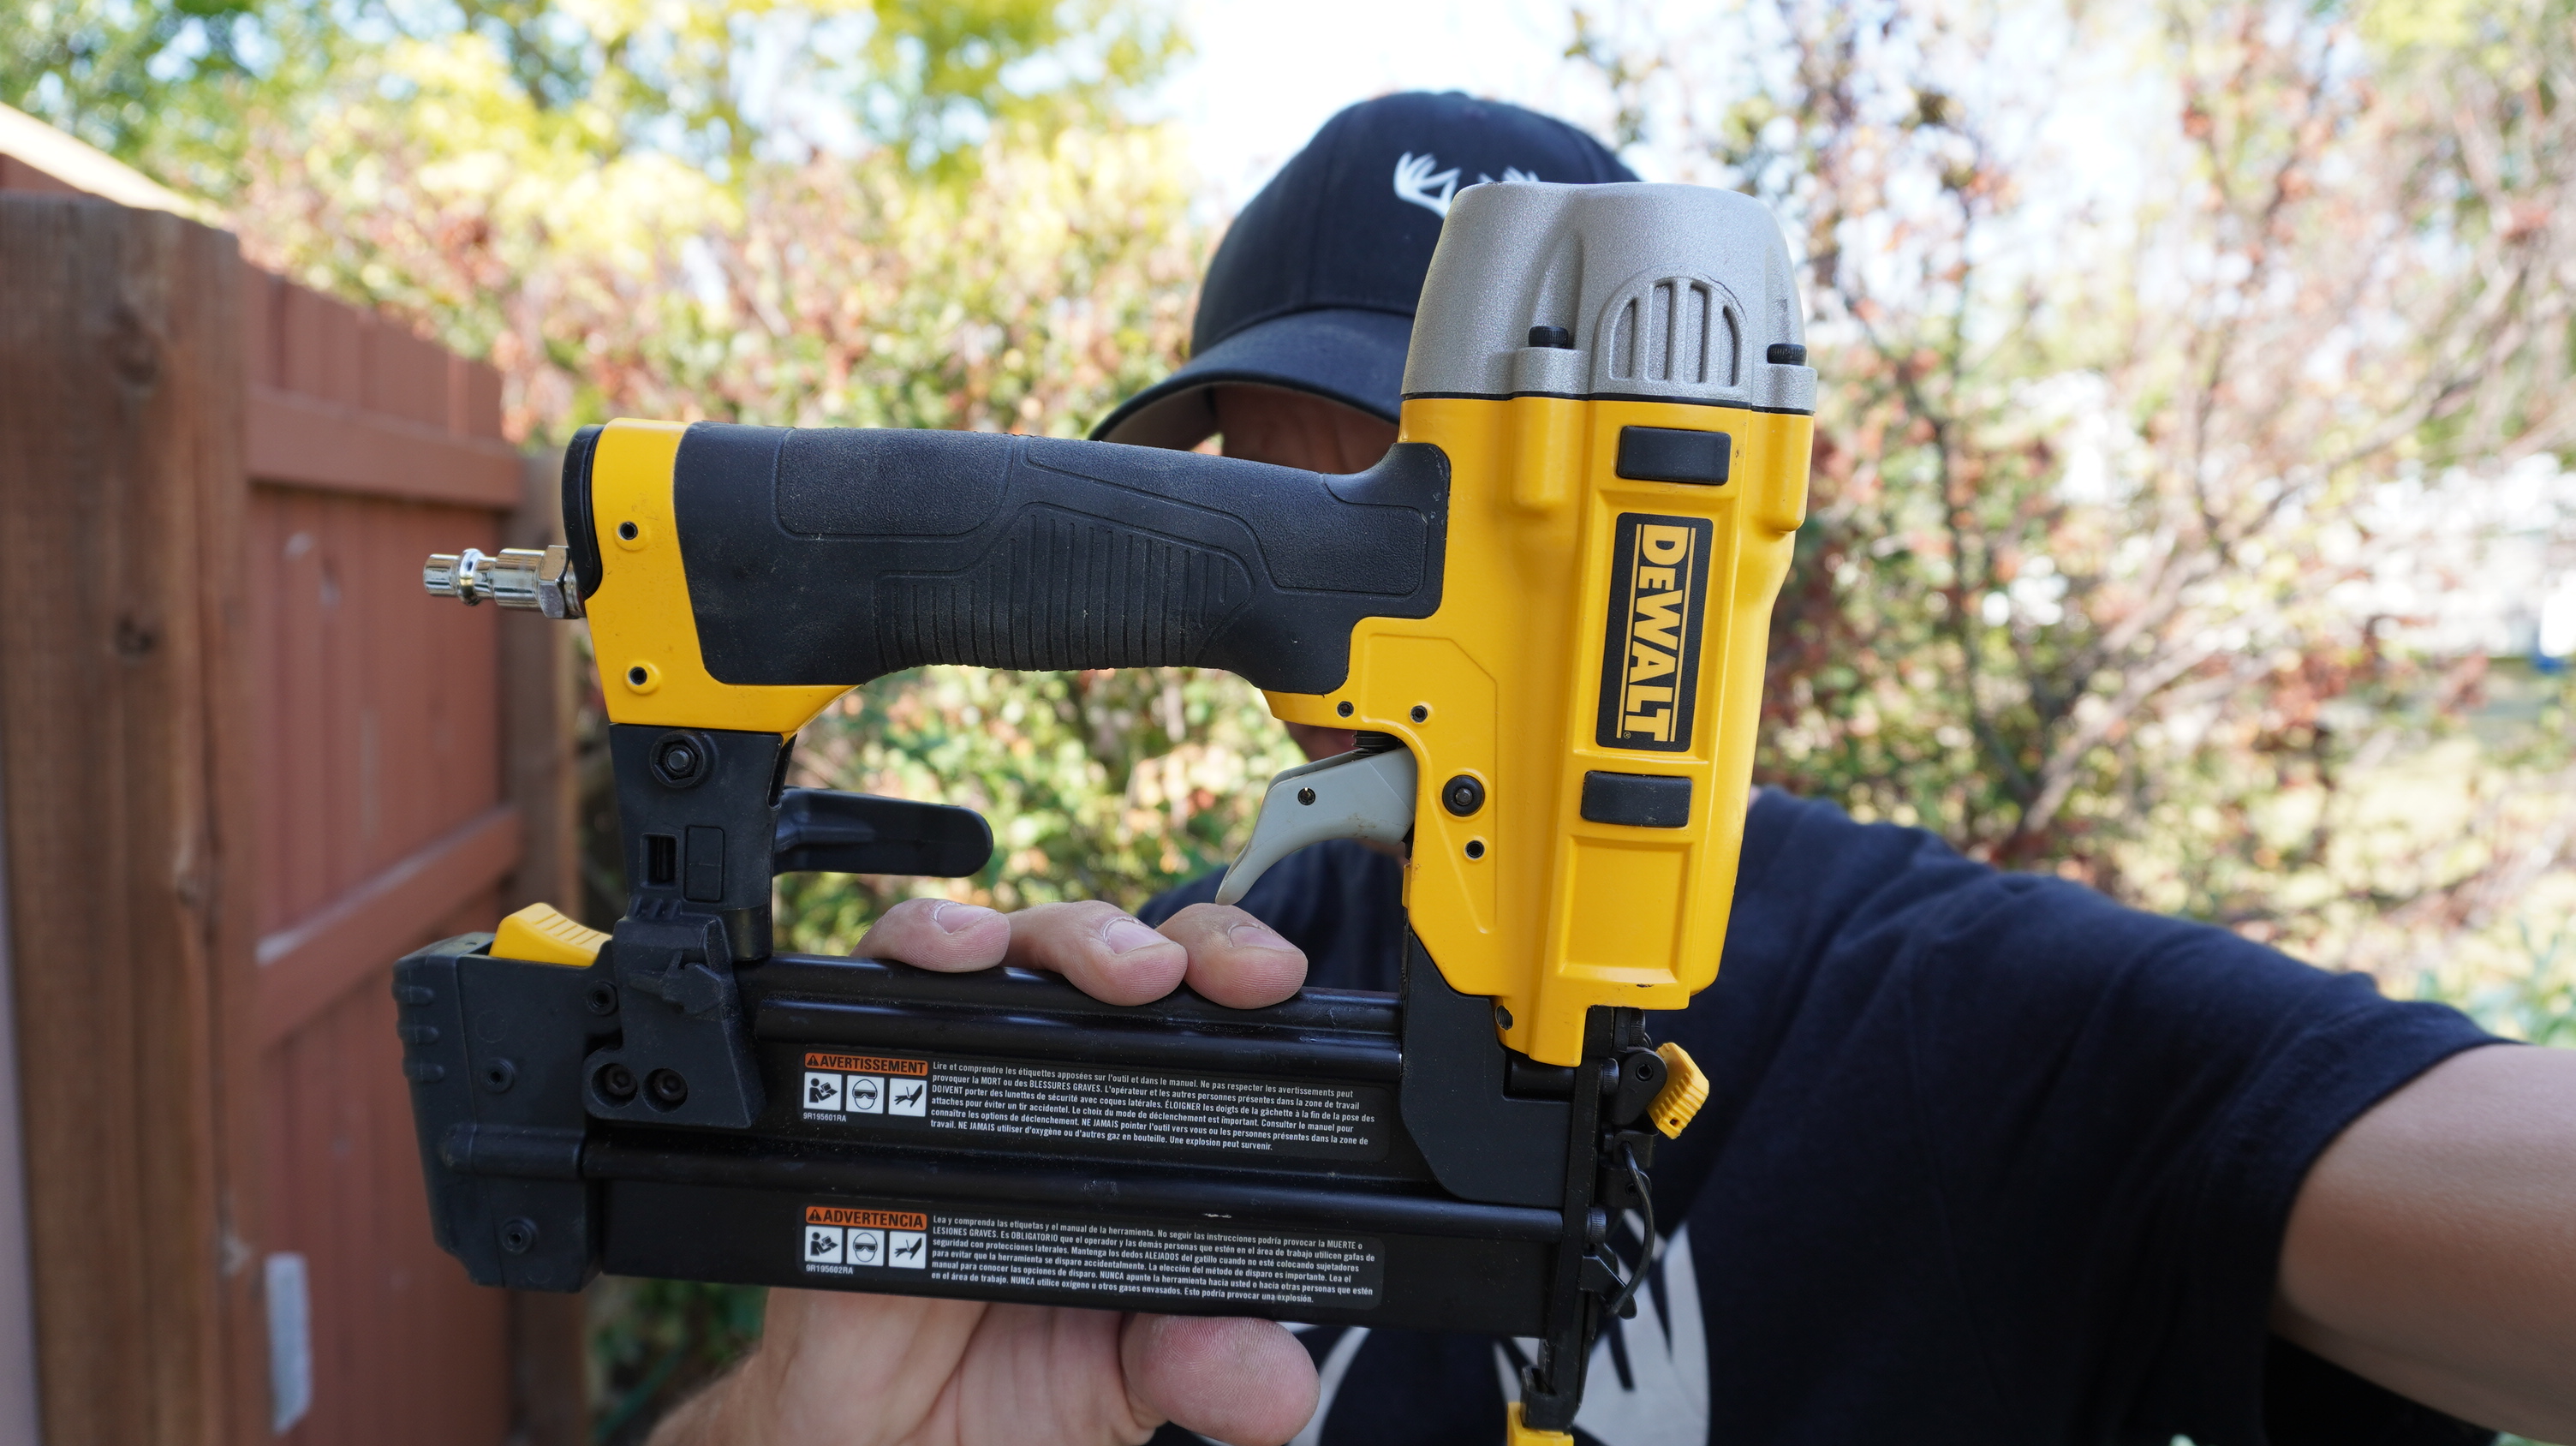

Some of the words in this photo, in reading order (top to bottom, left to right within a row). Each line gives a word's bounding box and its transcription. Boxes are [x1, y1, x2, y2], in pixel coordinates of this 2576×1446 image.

[820, 1055, 926, 1074] AVERTISSEMENT
[933, 1061, 947, 1071] Lire
[949, 1062, 957, 1072] et
[958, 1062, 1003, 1076] comprendre
[1005, 1066, 1017, 1075] les
[1017, 1067, 1055, 1079] étiquettes
[1057, 1069, 1092, 1082] apposées
[1107, 1073, 1129, 1083] l'outil
[1130, 1075, 1139, 1084] et
[1140, 1075, 1158, 1084] dans
[1160, 1076, 1166, 1085] le
[1169, 1077, 1198, 1087] manuel.
[1200, 1079, 1210, 1088] Ne
[1212, 1081, 1225, 1091] pas
[1227, 1081, 1263, 1094] respecter
[1265, 1083, 1276, 1092] les
[1278, 1084, 1334, 1096] avertissements
[1336, 1089, 1353, 1100] peut
[932, 1074, 970, 1085] provoquer
[971, 1075, 979, 1084] la
[981, 1076, 1001, 1086] MORT
[1014, 1078, 1028, 1088] des
[1029, 1079, 1070, 1090] BLESSURES
[1072, 1082, 1102, 1092] GRAVES.
[1105, 1084, 1148, 1097] L'opérateur
[1149, 1088, 1157, 1096] et
[1159, 1088, 1170, 1097] les
[1172, 1089, 1196, 1099] autres
[1197, 1092, 1236, 1103] personnes
[1237, 1093, 1274, 1106] présentes
[1276, 1096, 1294, 1105] dans
[1296, 1096, 1303, 1106] la
[1304, 1099, 1322, 1108] zone
[1324, 1098, 1333, 1108] de
[1335, 1099, 1359, 1109] travail
[932, 1084, 963, 1095] DOIVENT
[964, 1086, 987, 1098] porter
[989, 1088, 1003, 1097] des
[1005, 1089, 1035, 1099] lunettes
[1036, 1090, 1046, 1100] de
[1047, 1091, 1078, 1102] sécurité
[1099, 1096, 1126, 1108] coques
[1165, 1097, 1201, 1110] ÉLOIGNER
[1202, 1102, 1214, 1111] les
[1215, 1102, 1238, 1115] doigts
[1240, 1104, 1249, 1114] de
[1251, 1105, 1258, 1114] la
[1302, 1108, 1309, 1118] la
[1310, 1109, 1320, 1119] fin
[1321, 1110, 1331, 1120] de
[1333, 1110, 1339, 1120] la
[1341, 1113, 1359, 1123] pose
[1361, 1113, 1374, 1122] des
[803, 1112, 847, 1122] 9R195601RA
[931, 1095, 963, 1106] attaches
[964, 1099, 982, 1109] pour
[984, 1098, 1005, 1108] éviter
[1018, 1101, 1028, 1110] tir
[1029, 1102, 1070, 1113] accidentel.
[1071, 1104, 1081, 1114] Le
[1082, 1105, 1102, 1115] choix
[1104, 1107, 1113, 1116] du
[1115, 1108, 1136, 1118] mode
[1137, 1108, 1147, 1118] de
[1148, 1109, 1206, 1122] déclenchement
[1208, 1114, 1219, 1123] est
[1261, 1117, 1297, 1128] Consulter
[1298, 1120, 1305, 1129] le
[1307, 1120, 1334, 1131] manuel
[1336, 1124, 1353, 1134] pour
[930, 1118, 956, 1128] travail.
[957, 1120, 967, 1129] NE
[969, 1120, 995, 1131] JAMAIS
[997, 1122, 1023, 1132] utiliser
[1024, 1124, 1061, 1138] d'oxygène
[1074, 1127, 1106, 1138] d'autres
[1106, 1132, 1120, 1141] gaz
[1133, 1132, 1167, 1143] bouteille.
[1169, 1134, 1184, 1144] Une
[1185, 1135, 1220, 1148] explosion
[1222, 1138, 1239, 1149] peut
[1241, 1138, 1273, 1150] survenir.
[823, 1210, 924, 1228] ADVERTENCIA
[933, 1215, 946, 1224] Lea
[947, 1217, 951, 1226] y
[954, 1216, 995, 1229] comprenda
[997, 1218, 1008, 1228] las
[1009, 1219, 1043, 1232] etiquetas
[1045, 1223, 1049, 1232] y
[1051, 1222, 1058, 1231] el
[1059, 1222, 1087, 1233] manual
[1088, 1224, 1098, 1234] de
[1100, 1224, 1106, 1234] la
[1108, 1225, 1155, 1237] herramienta.
[1157, 1228, 1167, 1238] No
[1169, 1228, 1192, 1241] seguir
[1194, 1230, 1205, 1240] las
[1206, 1231, 1256, 1243] instrucciones
[1257, 1234, 1281, 1246] podría
[1283, 1238, 1316, 1249] provocar
[1318, 1238, 1325, 1247] la
[1327, 1239, 1356, 1249] MUERTE
[932, 1237, 969, 1250] seguridad
[970, 1240, 984, 1249] con
[985, 1240, 1033, 1253] protecciones
[1035, 1243, 1069, 1254] laterales.
[1070, 1245, 1106, 1258] Mantenga
[1108, 1247, 1119, 1257] los
[1121, 1248, 1143, 1258] dedos
[1144, 1250, 1179, 1261] ALEJADOS
[1181, 1252, 1192, 1261] del
[1194, 1252, 1217, 1264] gatillo
[1219, 1254, 1245, 1264] cuando
[1258, 1257, 1274, 1266] esté
[1276, 1258, 1314, 1269] colocando
[1315, 1260, 1359, 1274] sujetadores
[933, 1226, 967, 1236] LESIONES
[969, 1228, 998, 1239] GRAVES.
[1000, 1229, 1009, 1239] Es
[1011, 1230, 1058, 1242] OBLIGATORIO
[1059, 1235, 1073, 1245] que
[1075, 1234, 1082, 1244] el
[1083, 1234, 1118, 1247] operador
[1118, 1239, 1124, 1248] y
[1125, 1237, 1136, 1246] las
[1137, 1238, 1162, 1248] demás
[1164, 1241, 1197, 1252] personas
[1199, 1244, 1213, 1253] que
[1214, 1243, 1235, 1252] estén
[1247, 1245, 1255, 1254] el
[1256, 1246, 1273, 1255] área
[1274, 1246, 1284, 1256] de
[1286, 1247, 1312, 1259] trabajo
[1314, 1249, 1342, 1259] utilicen
[1343, 1251, 1364, 1263] gafas
[1365, 1252, 1374, 1261] de
[806, 1264, 854, 1275] 9R195602RA
